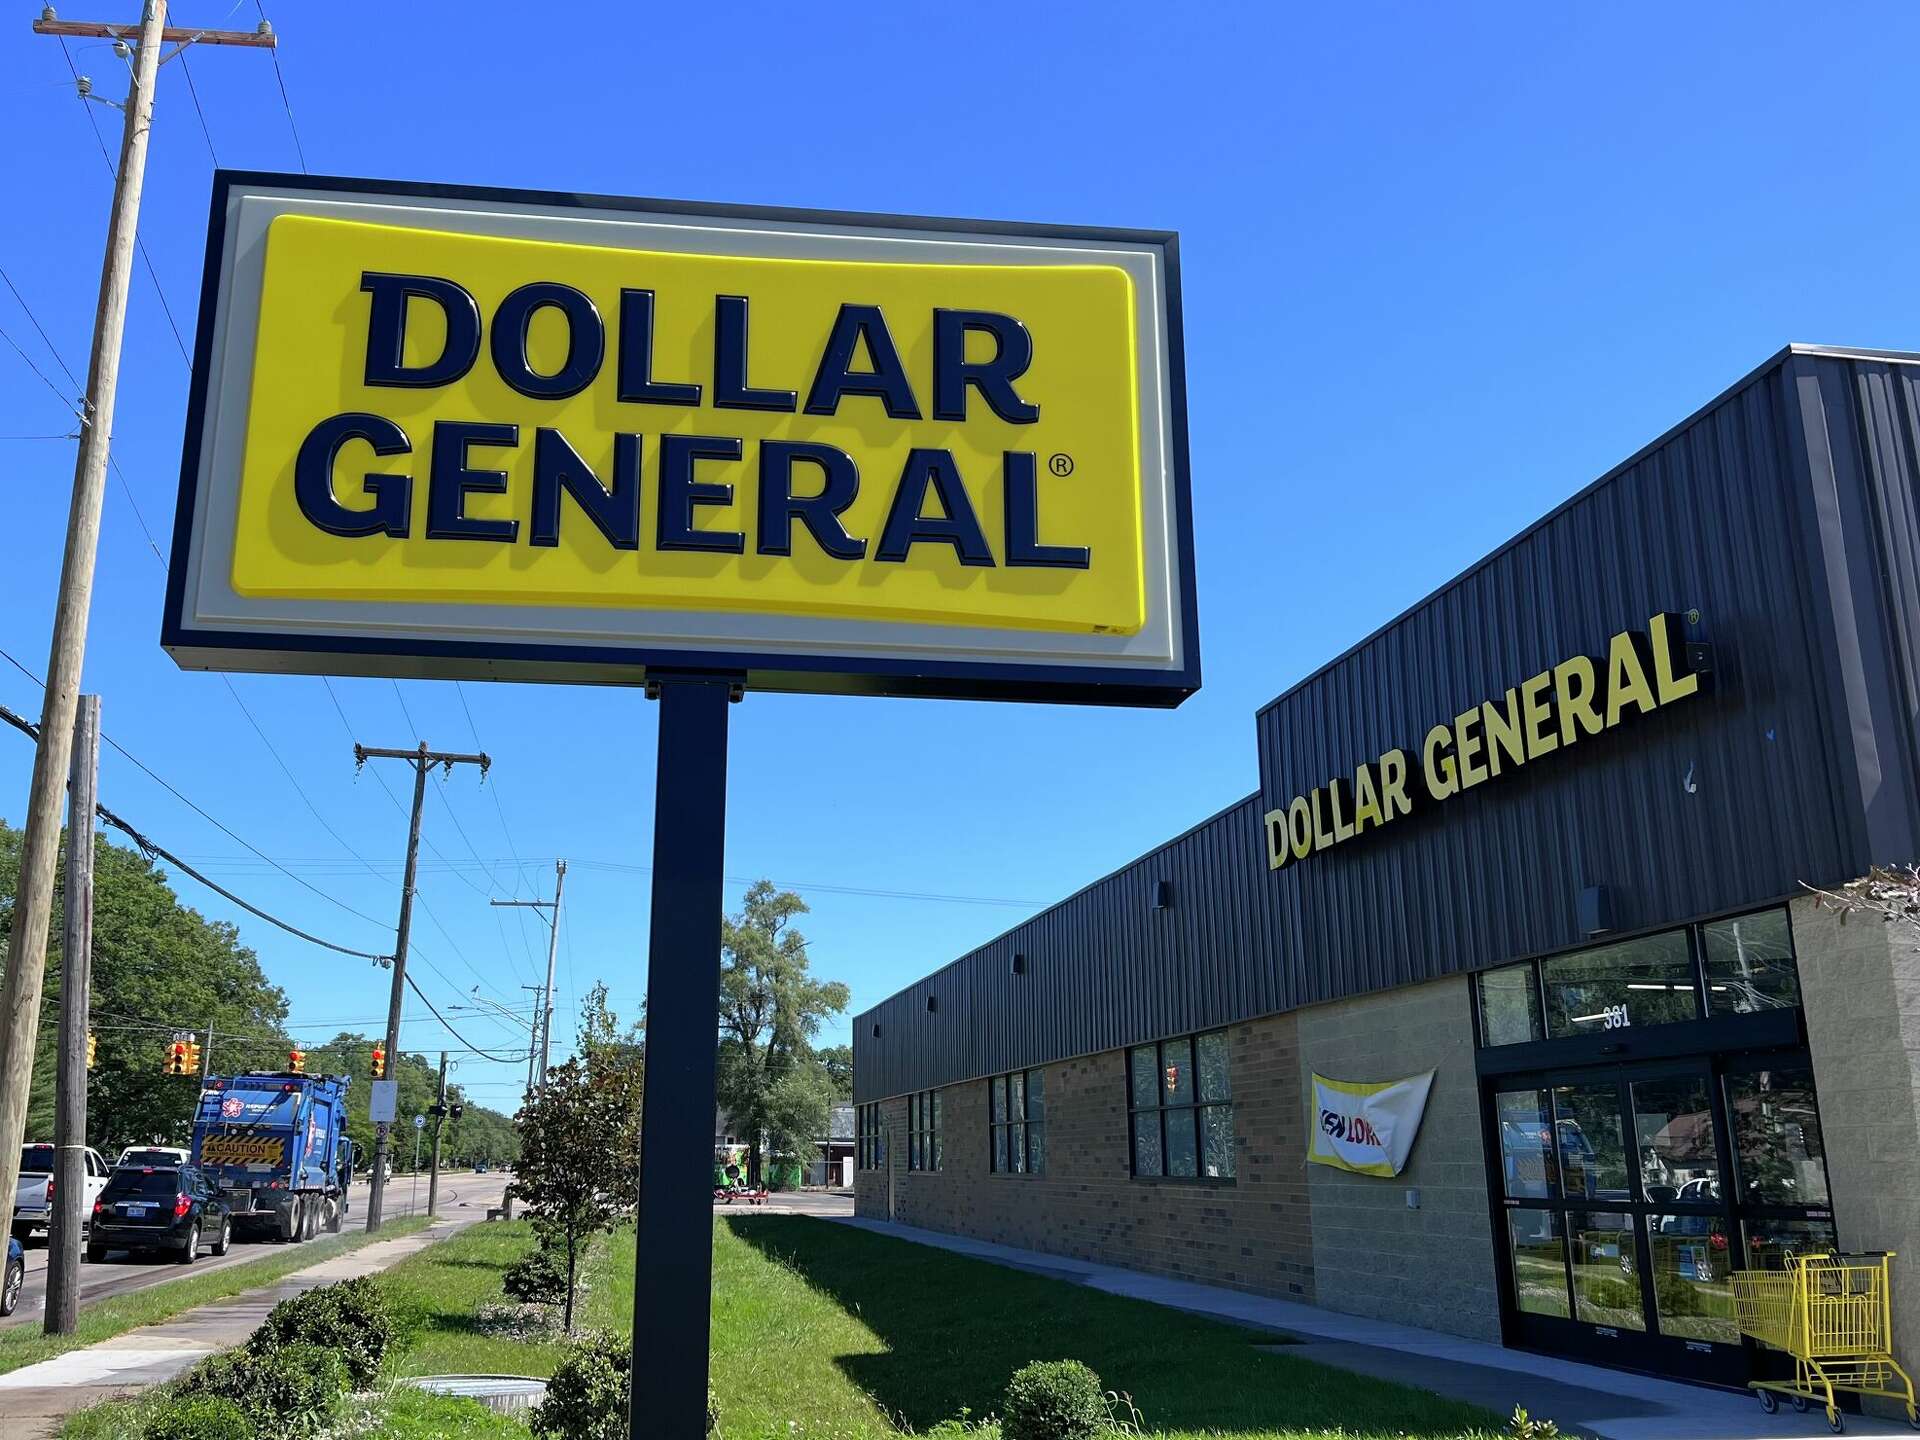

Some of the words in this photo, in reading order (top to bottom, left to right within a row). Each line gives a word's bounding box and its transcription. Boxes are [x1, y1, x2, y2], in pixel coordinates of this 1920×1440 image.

[360, 270, 1041, 426] DOLLAR
[294, 411, 1091, 571] GENERAL
[1264, 748, 1412, 871] DOLLAR
[1423, 612, 1698, 801] GENERAL
[1603, 1003, 1631, 1030] 381
[216, 1143, 266, 1154] CAUTION
